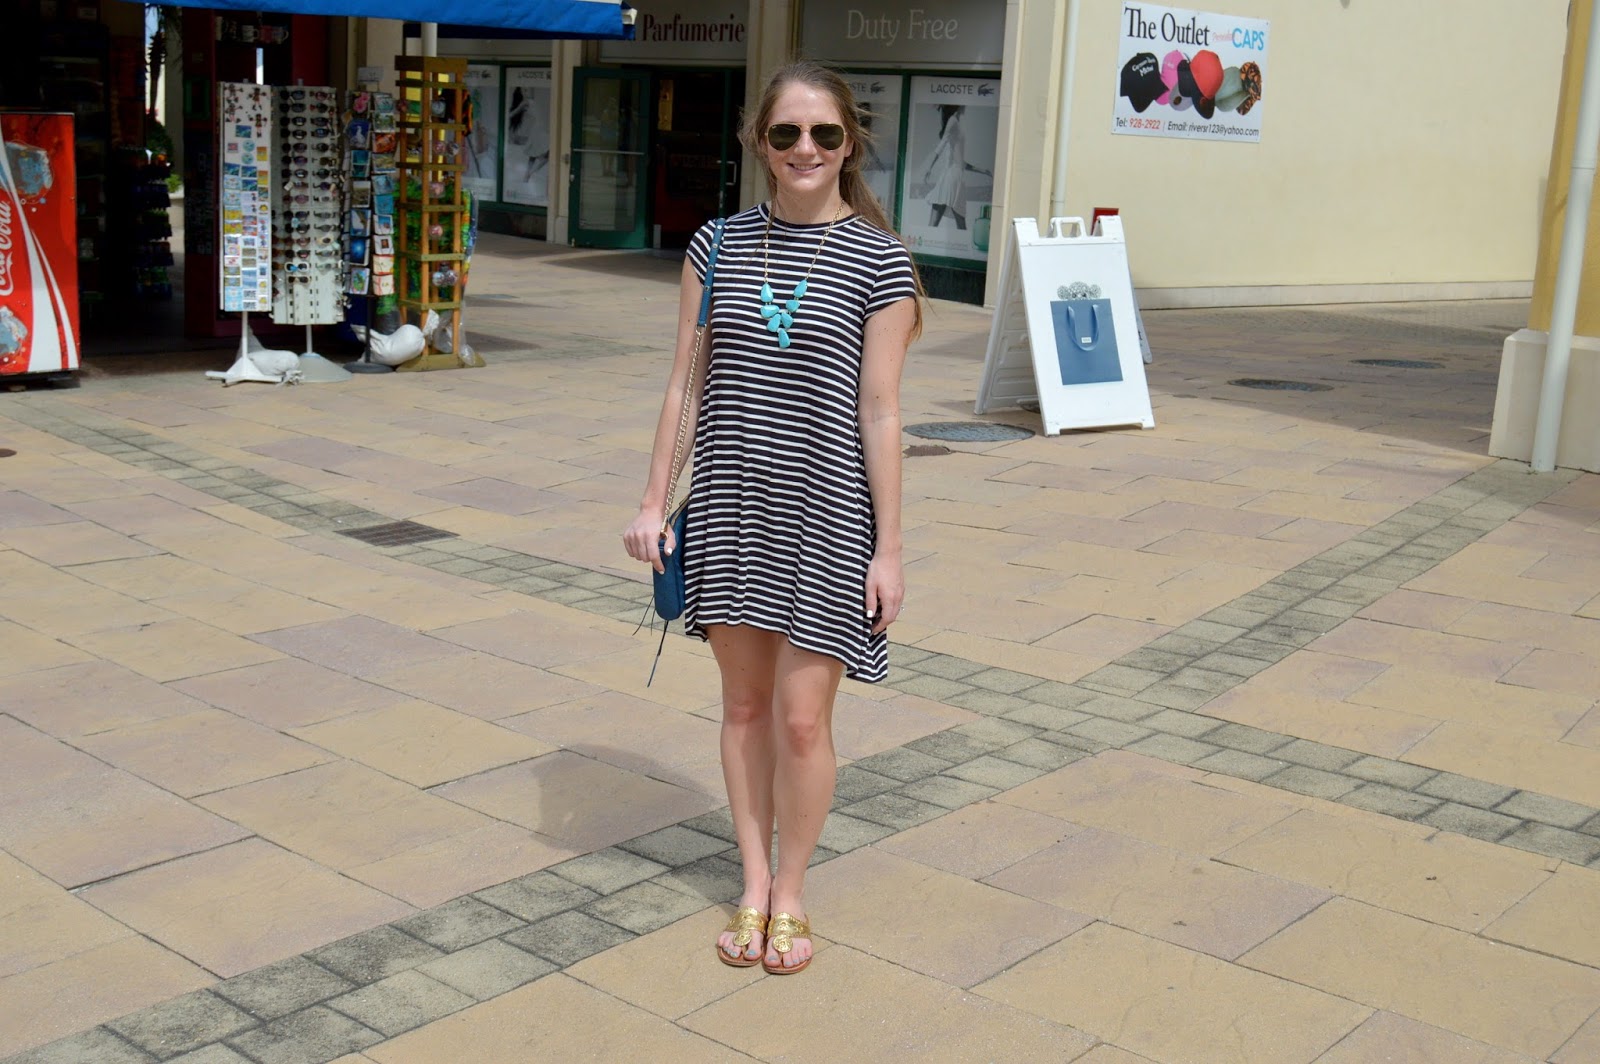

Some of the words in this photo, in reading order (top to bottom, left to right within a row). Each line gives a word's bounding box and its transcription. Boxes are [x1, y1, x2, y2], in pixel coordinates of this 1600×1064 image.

[642, 13, 745, 42] Parfumerie
[846, 9, 900, 47] Duty
[907, 9, 959, 40] Free
[1123, 6, 1157, 40] The
[1161, 12, 1210, 46] Outlet
[1231, 27, 1265, 51] CAPS
[930, 83, 973, 95] LACOSTE
[1116, 117, 1128, 127] Tel:
[1129, 117, 1161, 130] 928-2922
[1167, 120, 1187, 131] Email:
